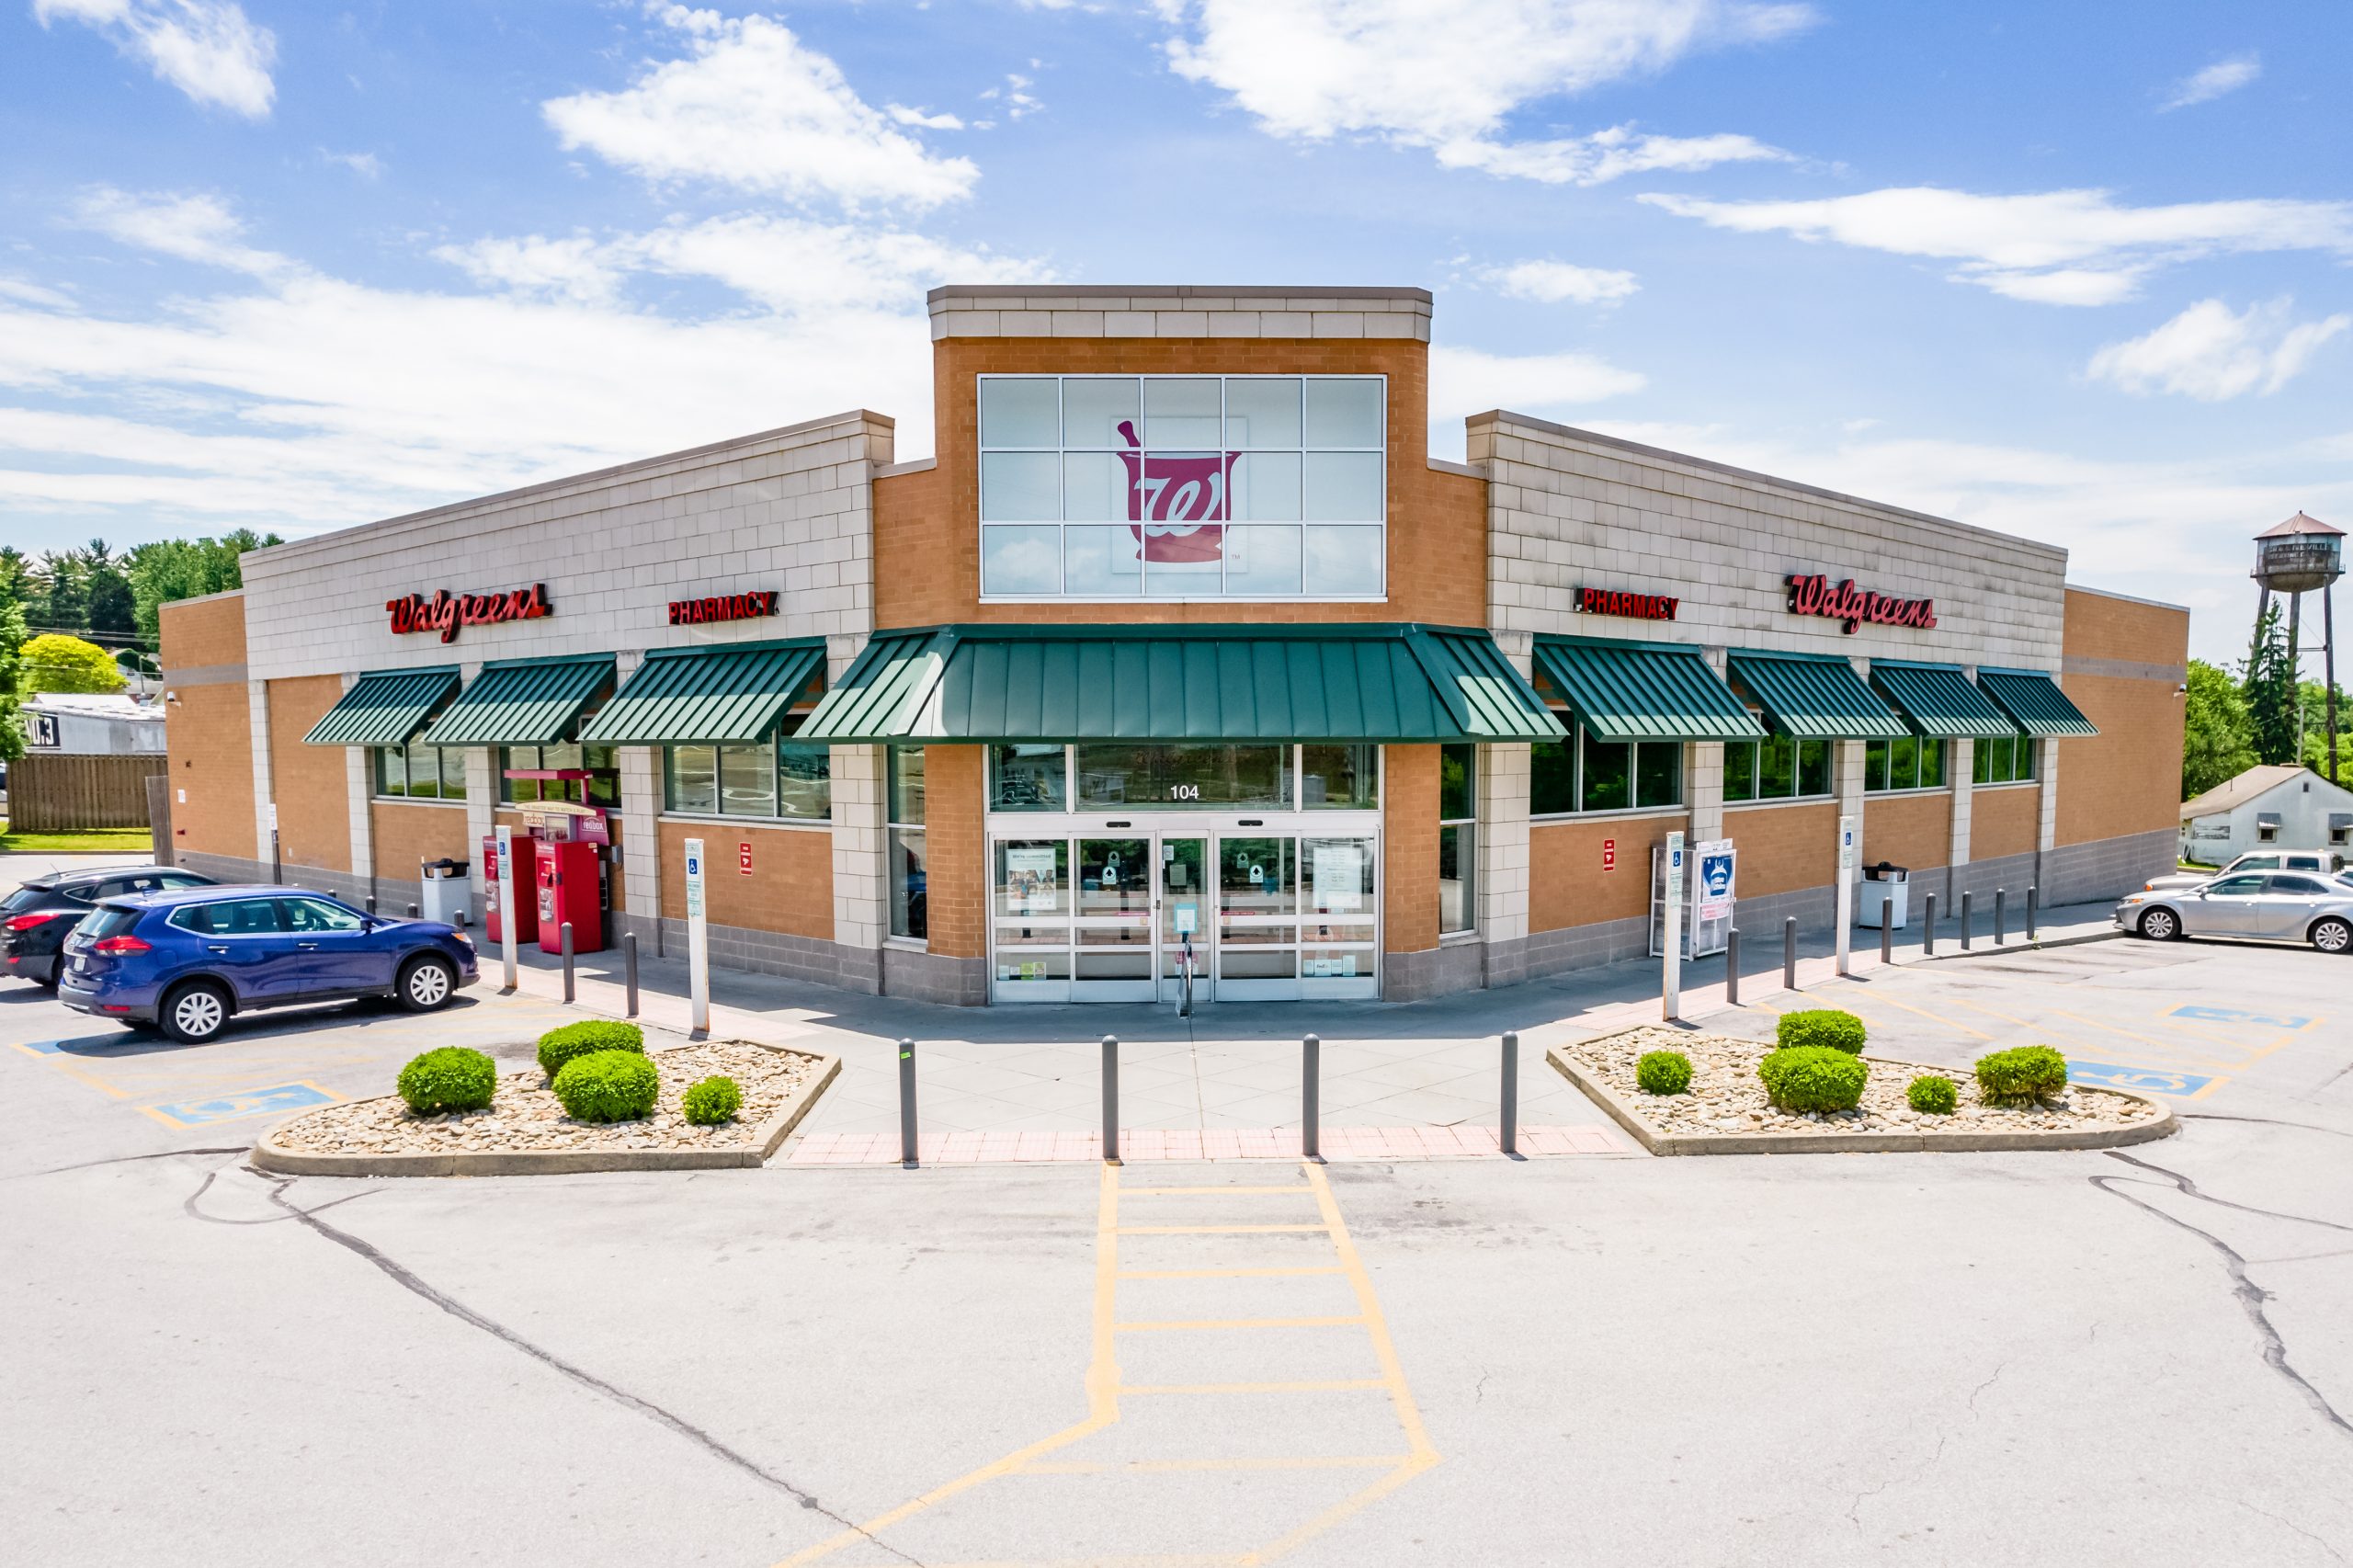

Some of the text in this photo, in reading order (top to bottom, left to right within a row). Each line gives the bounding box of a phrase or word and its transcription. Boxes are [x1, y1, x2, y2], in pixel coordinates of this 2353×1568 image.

[386, 583, 549, 643] Walgreens
[668, 591, 776, 625] PHARMACY
[1582, 586, 1680, 621] PHARMACY
[1790, 574, 1938, 635] Walgreens
[1170, 785, 1199, 800] 104
[583, 820, 604, 830] redbox
